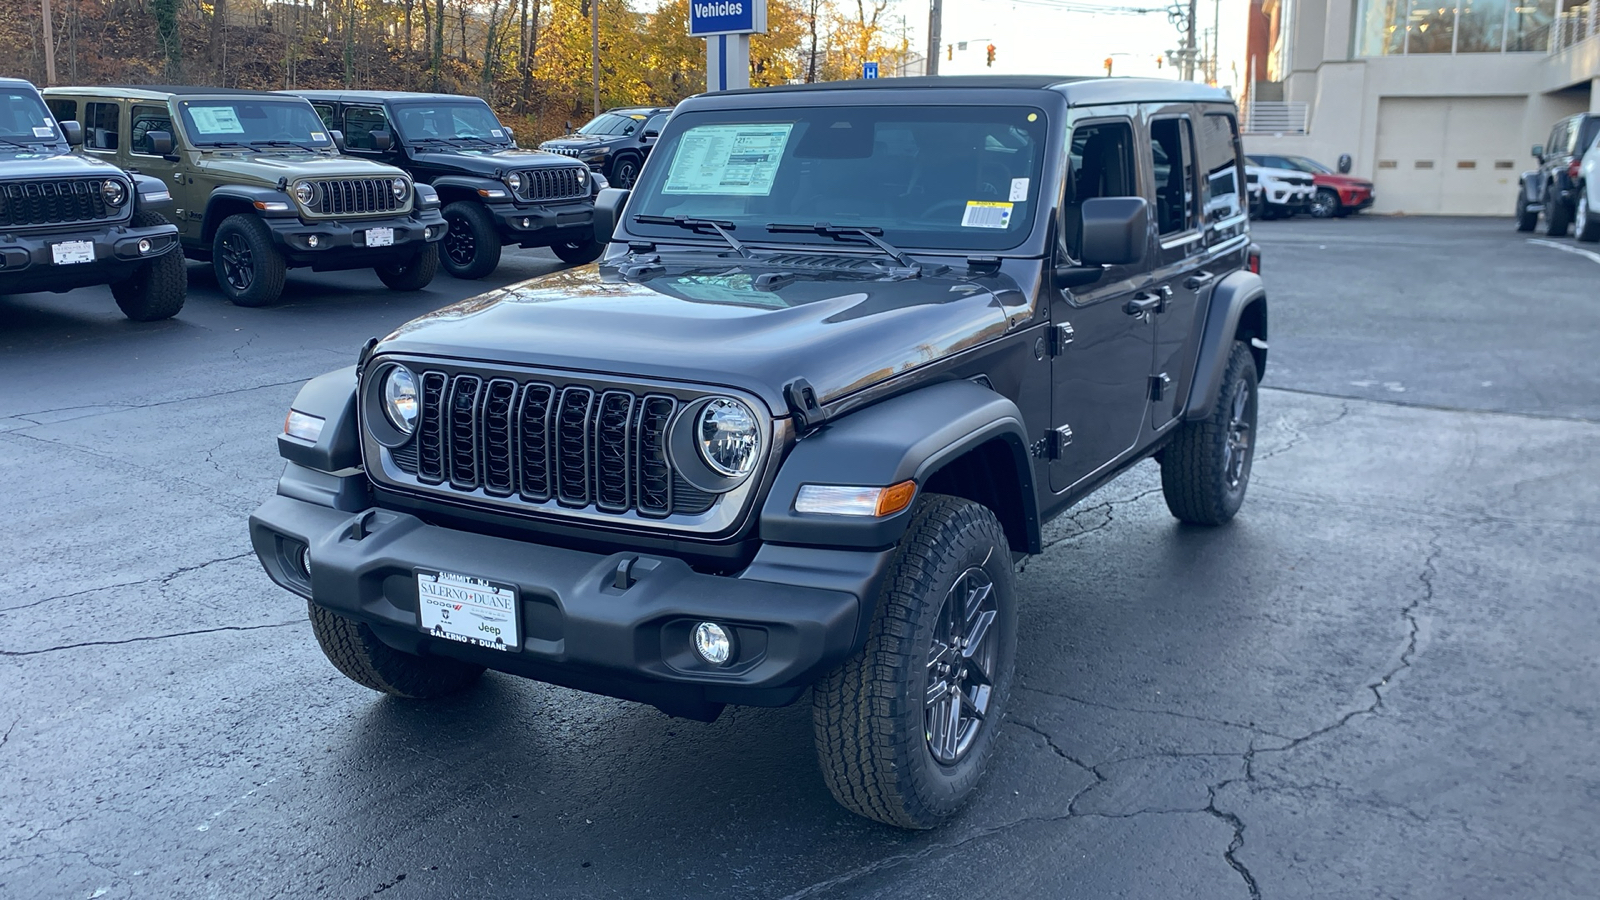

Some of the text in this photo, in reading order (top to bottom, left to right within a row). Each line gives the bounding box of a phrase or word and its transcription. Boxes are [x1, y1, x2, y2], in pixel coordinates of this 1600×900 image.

[694, 1, 743, 18] Vehicles
[866, 67, 876, 79] H
[477, 579, 489, 587] NJ
[421, 582, 512, 610] SALERNO DUANE
[478, 622, 501, 636] Jeep
[430, 629, 507, 651] SALERNO DUANE
